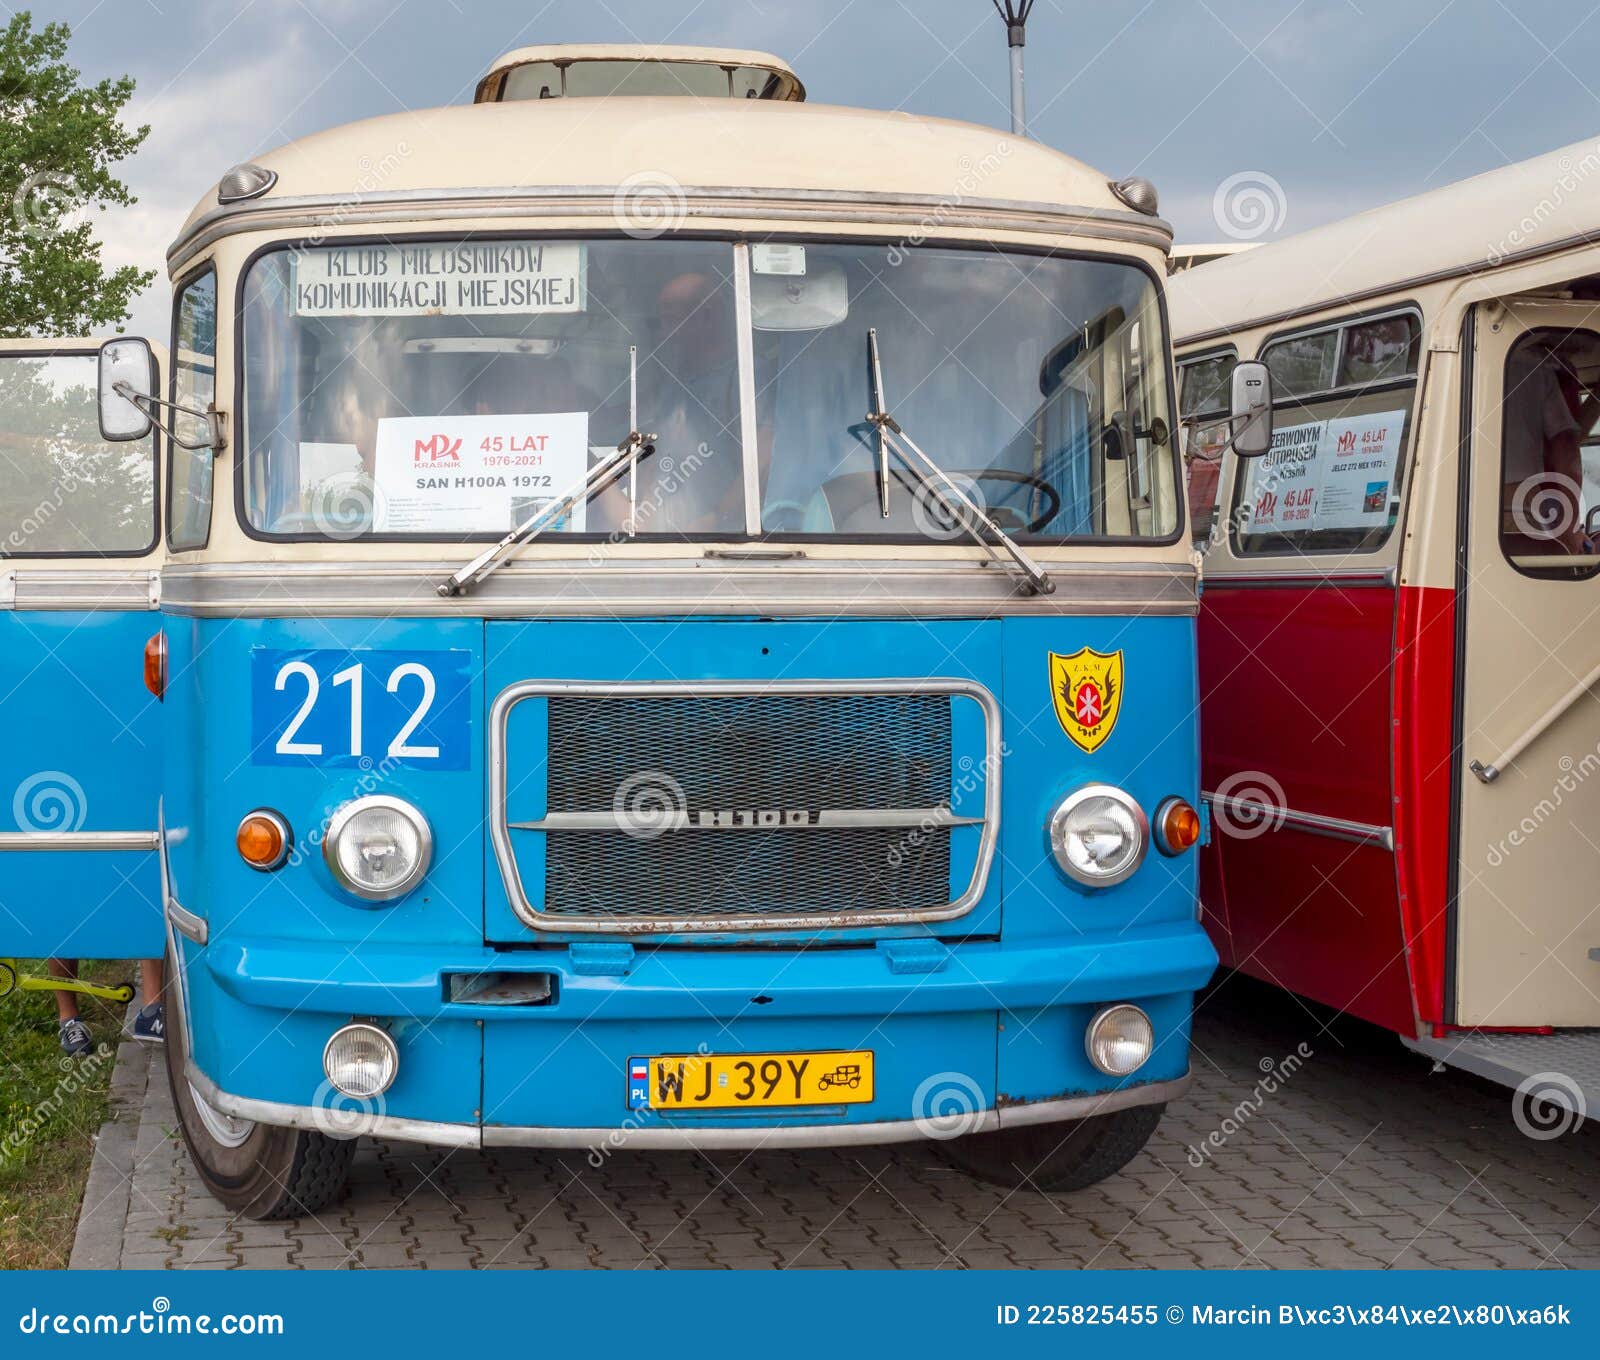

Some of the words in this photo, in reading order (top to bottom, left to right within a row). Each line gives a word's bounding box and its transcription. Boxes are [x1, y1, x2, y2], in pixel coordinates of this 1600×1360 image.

[327, 250, 388, 277] KLUB
[298, 281, 447, 309] KOMUNIKACJI
[458, 278, 575, 307] MIEJSKIEJ
[480, 437, 503, 451] 45
[510, 436, 549, 451] LAT
[1361, 431, 1371, 443] 45
[1372, 429, 1388, 443] LAT
[483, 455, 543, 466] 1976-2021
[416, 478, 449, 489] SAN
[455, 477, 506, 488] H100A
[513, 475, 551, 487] 1972
[1284, 490, 1297, 507] 45
[1297, 488, 1314, 506] LAT
[275, 661, 440, 758] 212
[657, 1061, 712, 1102] WJ
[734, 1059, 810, 1101] 39Y
[632, 1089, 647, 1100] PL
